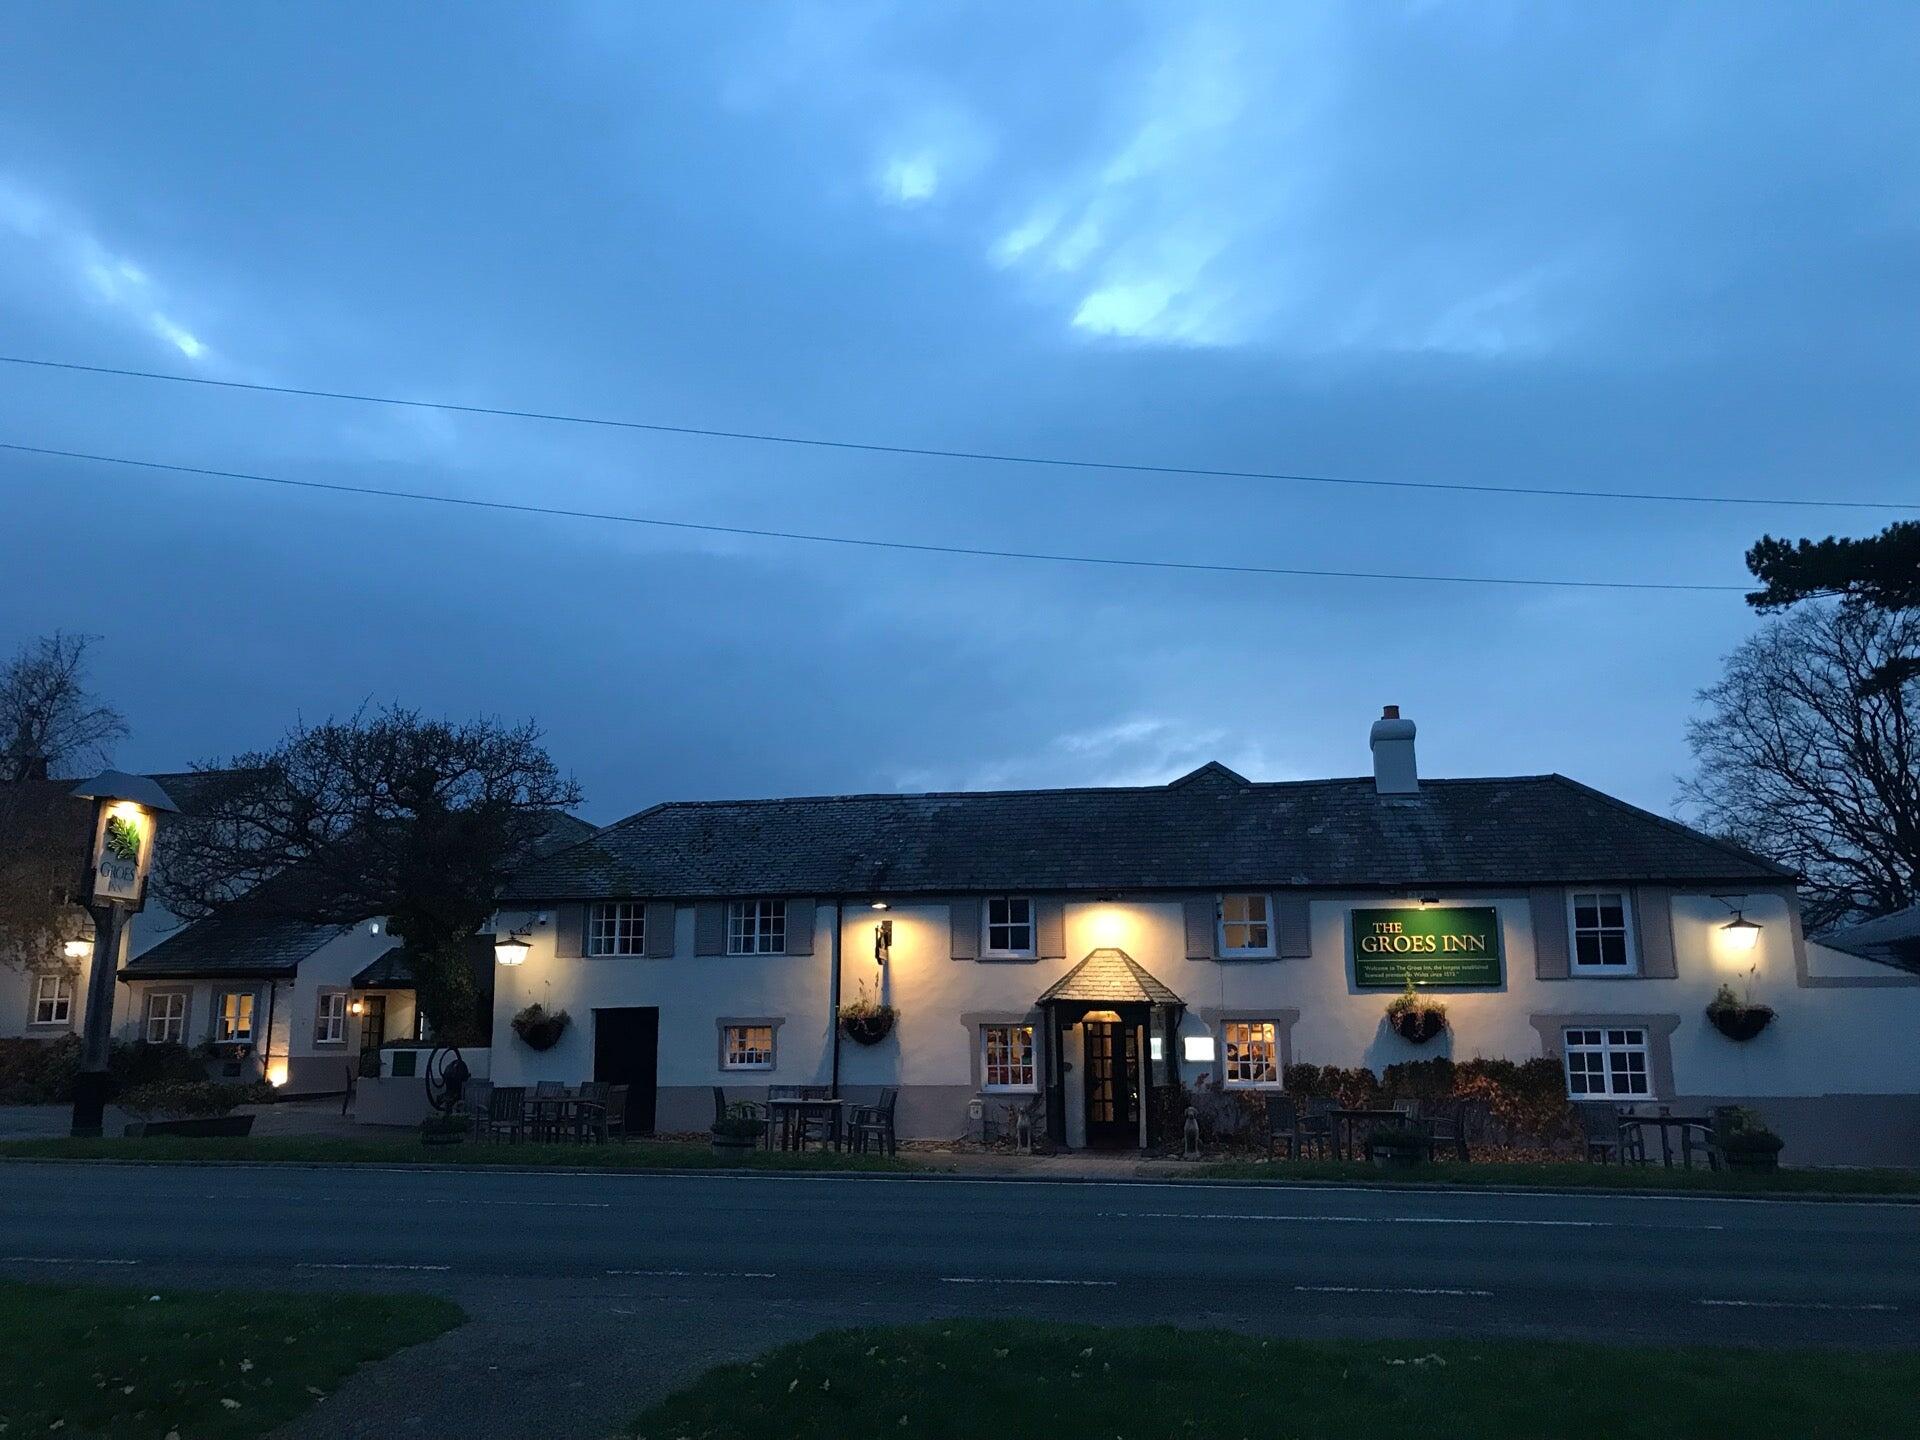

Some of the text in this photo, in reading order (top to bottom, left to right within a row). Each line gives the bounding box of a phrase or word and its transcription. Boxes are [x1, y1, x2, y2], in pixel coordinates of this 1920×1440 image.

[1373, 922, 1403, 934] THE
[1361, 934, 1486, 953] GROES INN
